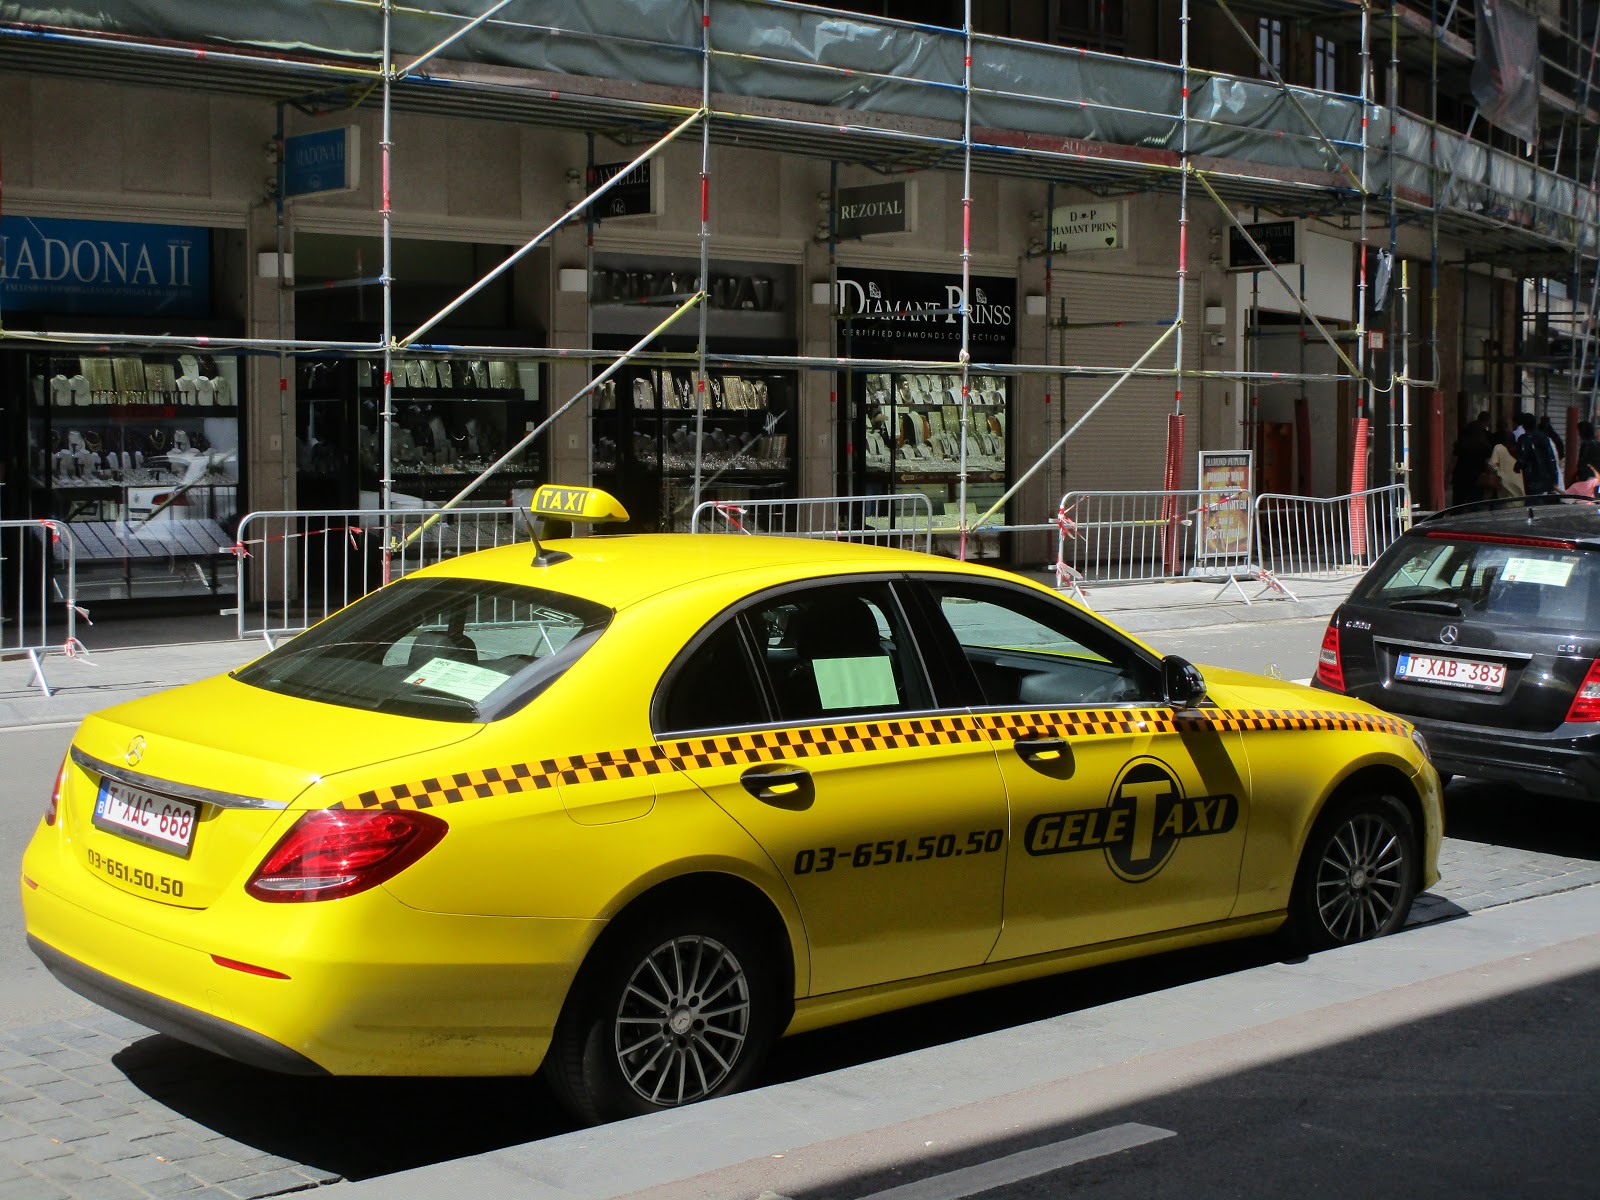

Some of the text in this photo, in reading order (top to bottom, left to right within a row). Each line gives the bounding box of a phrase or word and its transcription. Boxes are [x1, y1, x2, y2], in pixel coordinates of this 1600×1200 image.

[841, 200, 902, 220] REZOTAL
[1091, 222, 1117, 232] PRINS
[168, 245, 192, 286] II
[836, 279, 1011, 325] DIAMANT PRINSS
[896, 330, 945, 340] DIAMONDS
[948, 332, 1006, 341] COECTION
[541, 490, 585, 511] TAXI
[97, 802, 105, 814] B
[1030, 807, 1130, 852] GELE
[794, 829, 1004, 875] 03-651.50.50
[88, 848, 184, 898] 03-651.50.50
